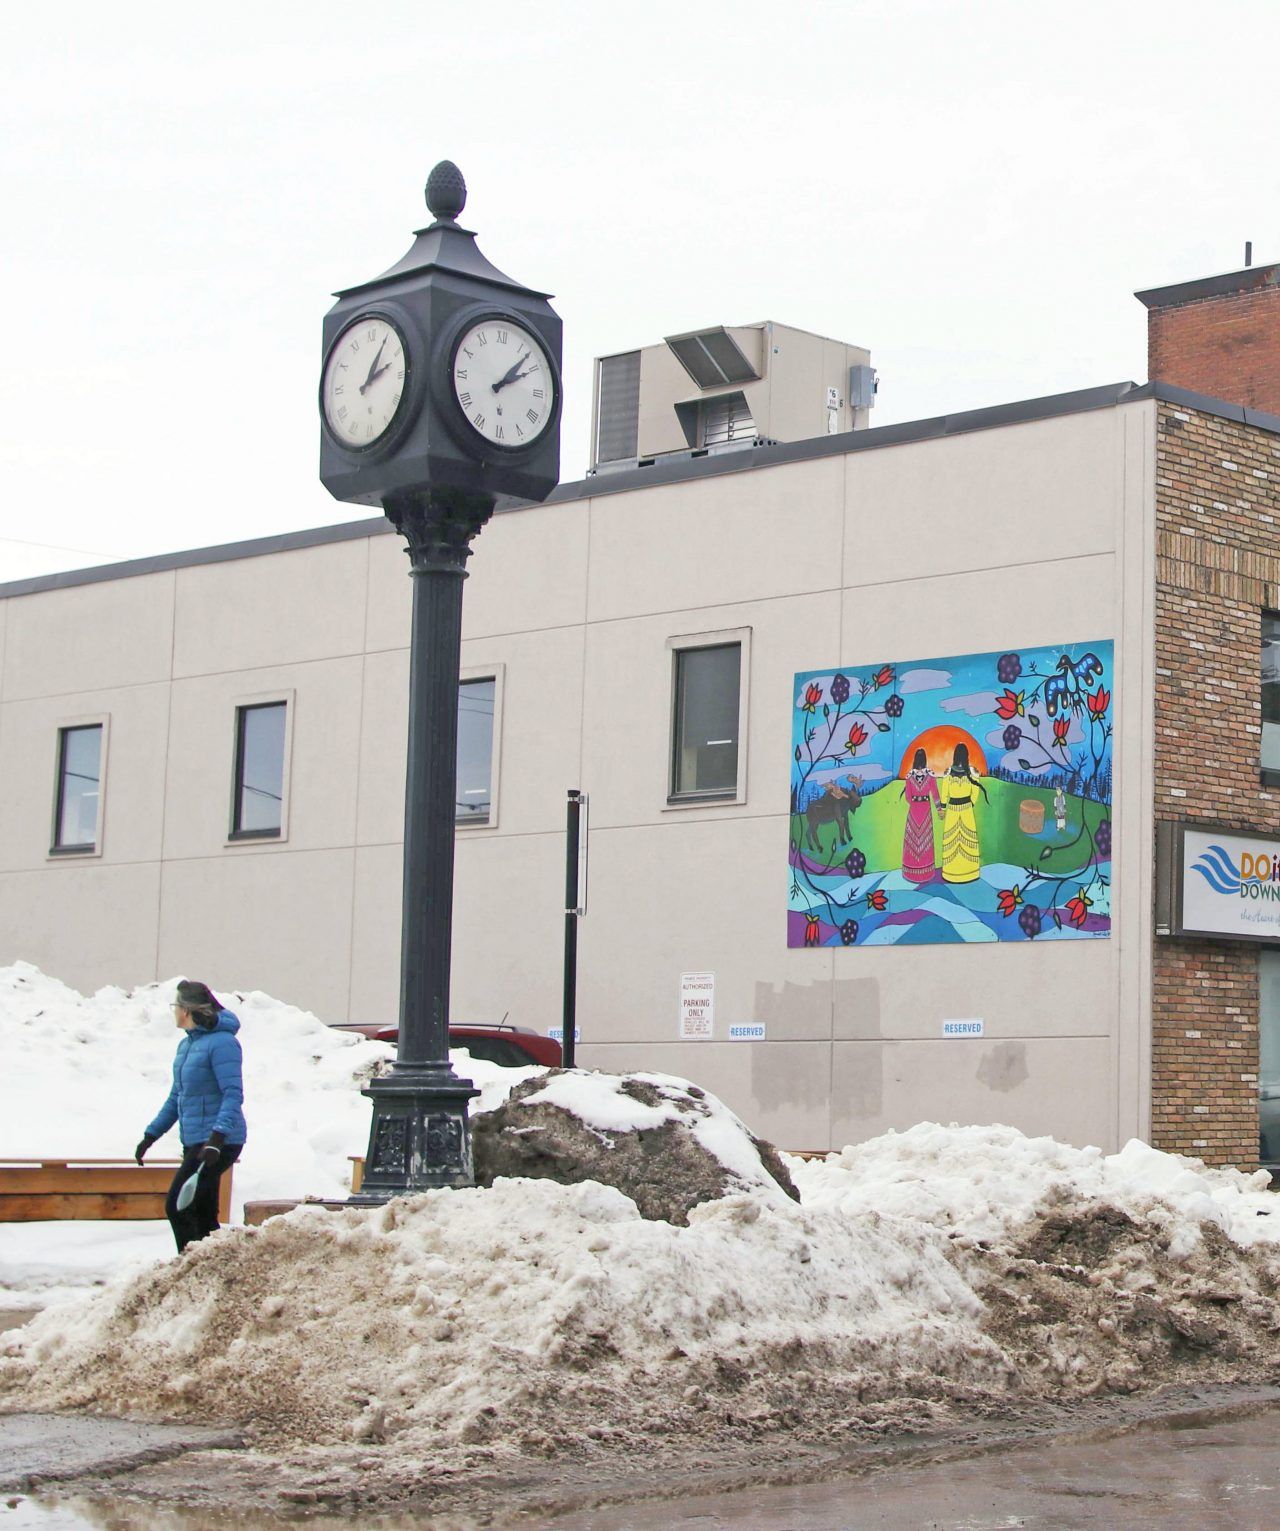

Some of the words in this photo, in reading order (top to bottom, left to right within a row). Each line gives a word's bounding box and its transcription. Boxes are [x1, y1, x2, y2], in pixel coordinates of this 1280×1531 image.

[496, 330, 508, 344] XII
[533, 389, 543, 398] III
[684, 998, 710, 1007] PARKING
[730, 1027, 764, 1036] RESERVED
[944, 1024, 981, 1032] RESERVED
